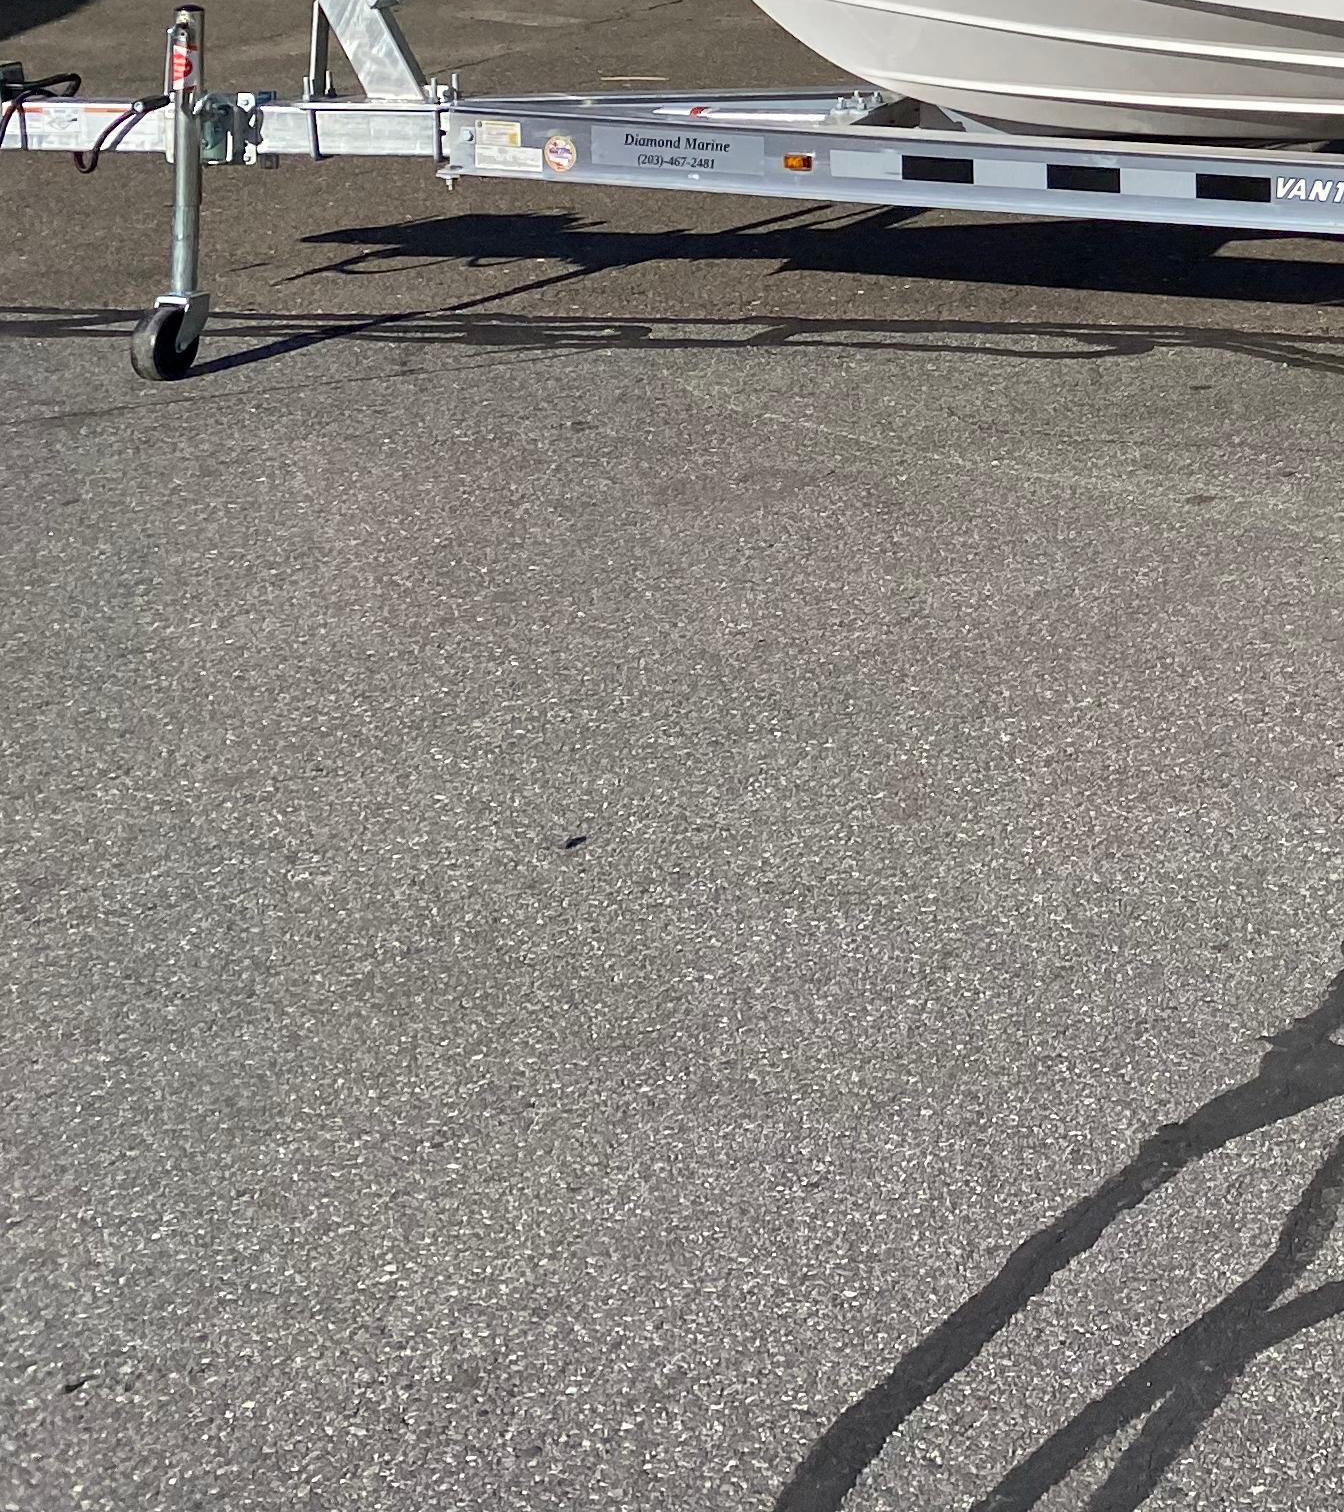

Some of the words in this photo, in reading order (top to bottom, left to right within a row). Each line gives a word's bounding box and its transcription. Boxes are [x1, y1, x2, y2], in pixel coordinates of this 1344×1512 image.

[623, 133, 681, 151] Diamond
[684, 136, 731, 153] Marine
[637, 153, 716, 170] (203)-467-2481
